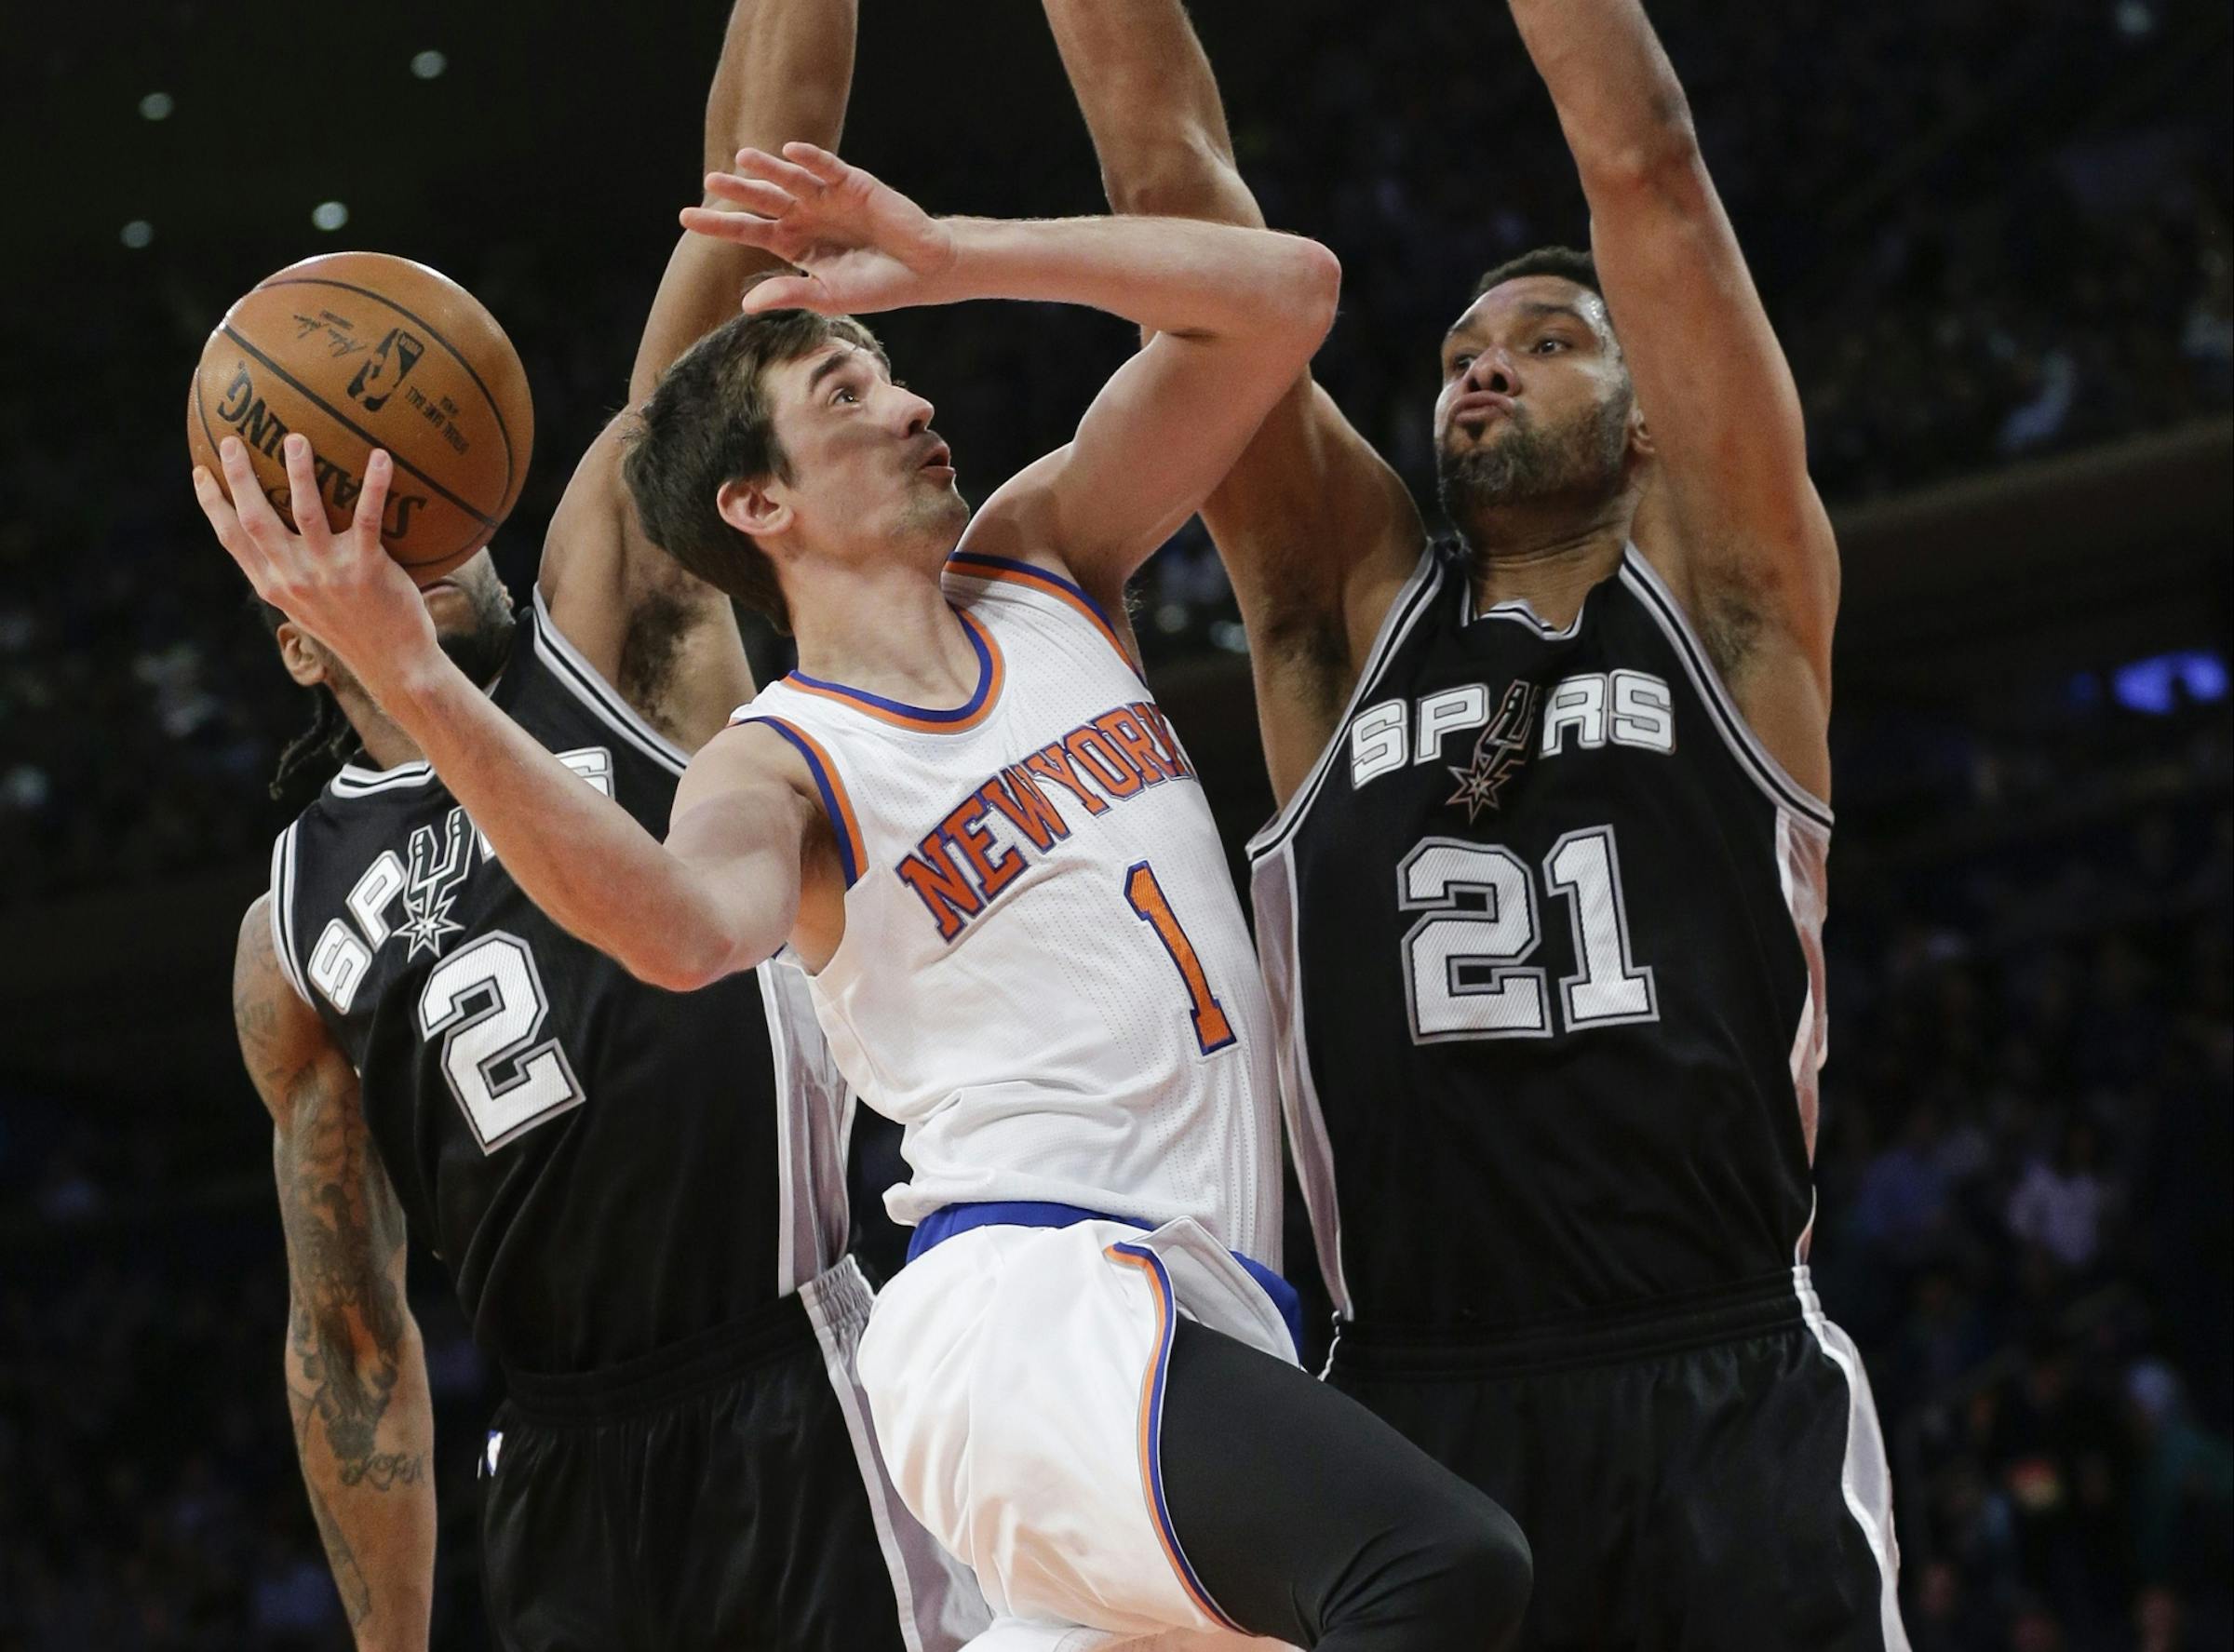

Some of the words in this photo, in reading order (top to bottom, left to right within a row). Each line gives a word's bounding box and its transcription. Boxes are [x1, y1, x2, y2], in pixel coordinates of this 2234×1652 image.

[217, 369, 427, 540] SALING
[307, 746, 615, 1015] SPU
[895, 765, 1071, 945] NEW
[1024, 702, 1199, 817] YORK
[1396, 824, 1660, 1045] 21
[418, 930, 586, 1156] 2
[1124, 860, 1236, 1056] 1
